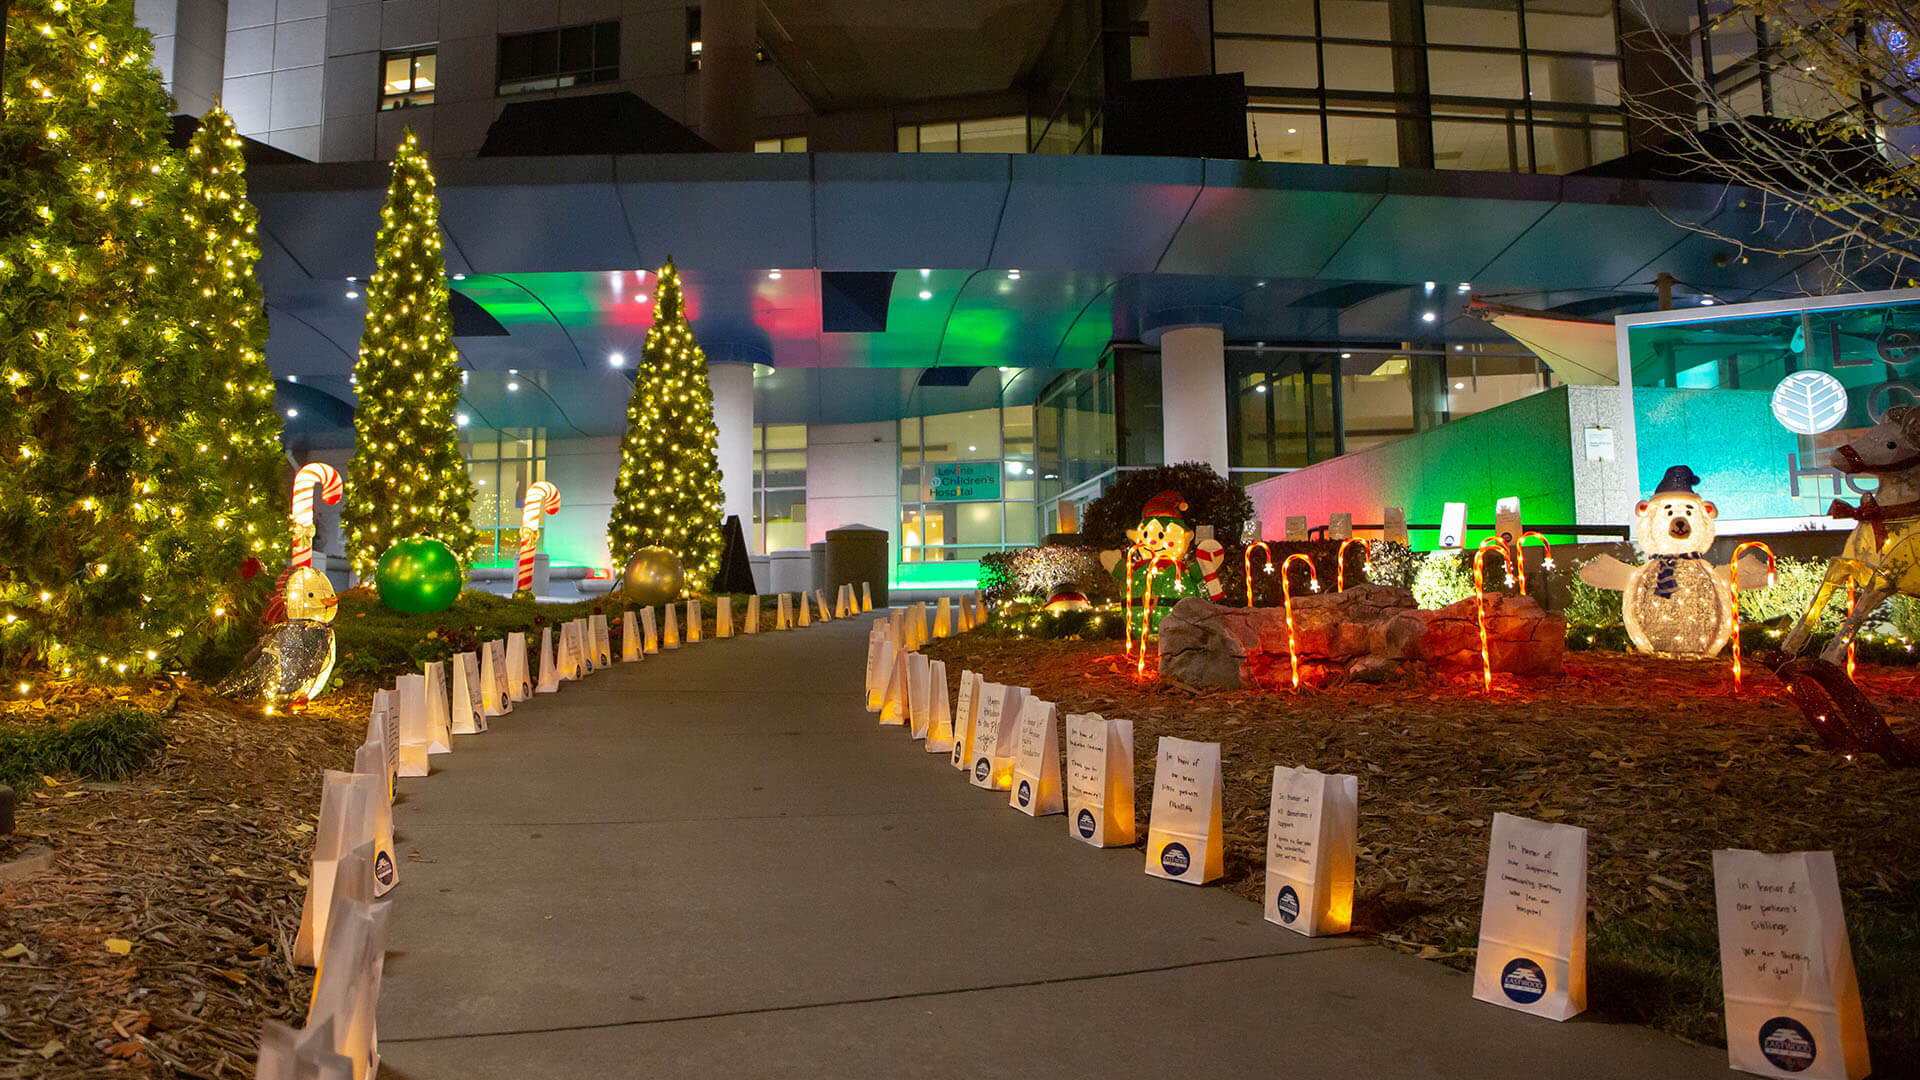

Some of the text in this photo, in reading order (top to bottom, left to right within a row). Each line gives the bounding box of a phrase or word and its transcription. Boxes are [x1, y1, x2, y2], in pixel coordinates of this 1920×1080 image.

[938, 464, 974, 476] Levine
[942, 476, 995, 486] Children's
[929, 486, 974, 497] Hospital
[1508, 840, 1553, 859] In honor of
[1737, 877, 1796, 894] In honor of
[1757, 962, 1766, 972] of
